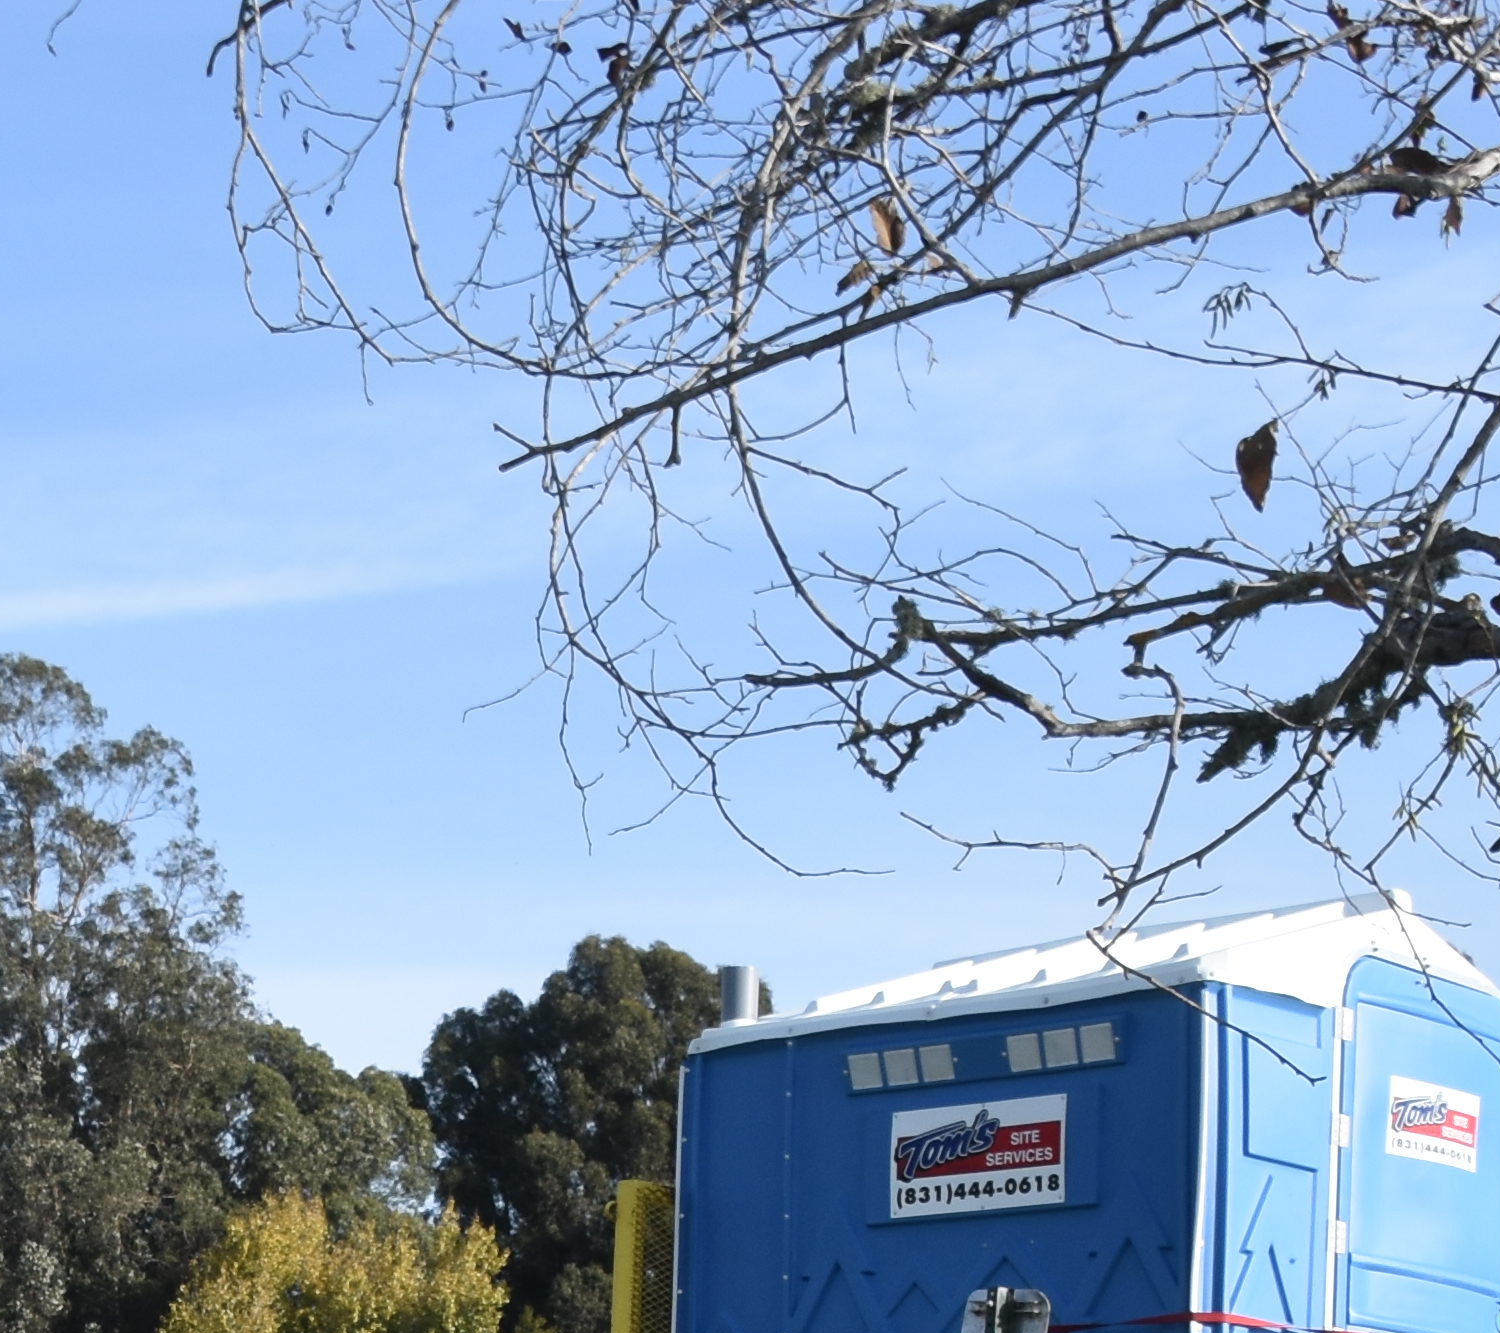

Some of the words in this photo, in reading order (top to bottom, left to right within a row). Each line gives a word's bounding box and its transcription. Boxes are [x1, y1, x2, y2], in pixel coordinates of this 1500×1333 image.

[1391, 1092, 1448, 1132] Tom's
[895, 1109, 1000, 1182] Tom's
[1010, 1130, 1040, 1146] SITE
[985, 1147, 1053, 1166] SERVICES
[897, 1174, 1060, 1209] (831)444-0618
